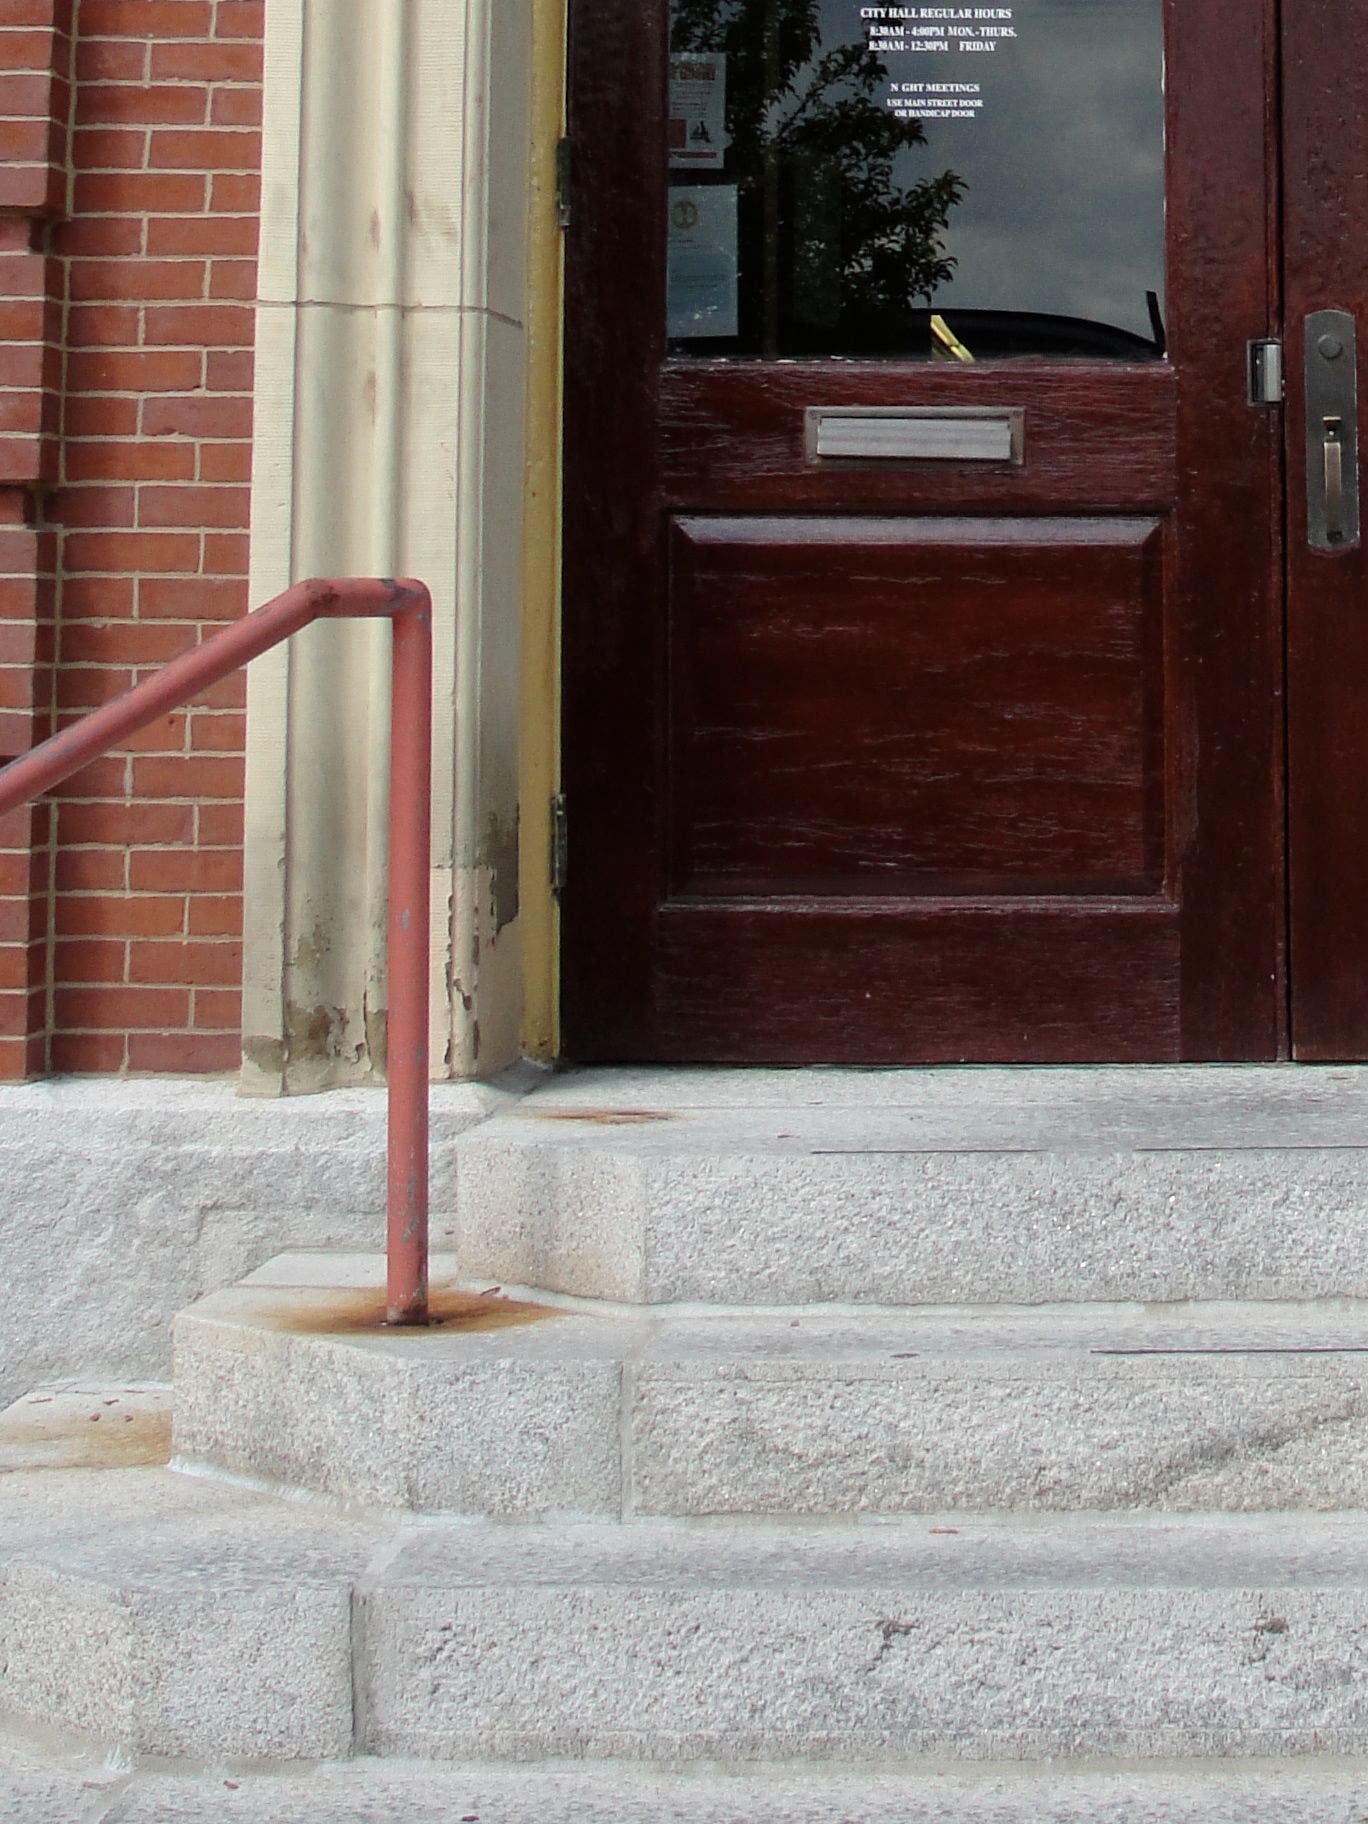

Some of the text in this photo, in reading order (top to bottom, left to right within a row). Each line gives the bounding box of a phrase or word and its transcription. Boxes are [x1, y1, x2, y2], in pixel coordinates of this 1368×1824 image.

[860, 7, 1012, 20] CITY HALL REGULAR HOURS
[869, 26, 904, 37] 8:30AM
[911, 26, 945, 37] 4:00PM
[868, 40, 904, 52] 8:30AM
[910, 41, 949, 52] 12:30PM
[959, 41, 997, 52] FRIDAY
[890, 83, 980, 93] NGHT MEETINGS
[886, 98, 984, 108] USE MAIN STREET DOOR
[894, 109, 975, 118] OR HANDICAP DOOR
